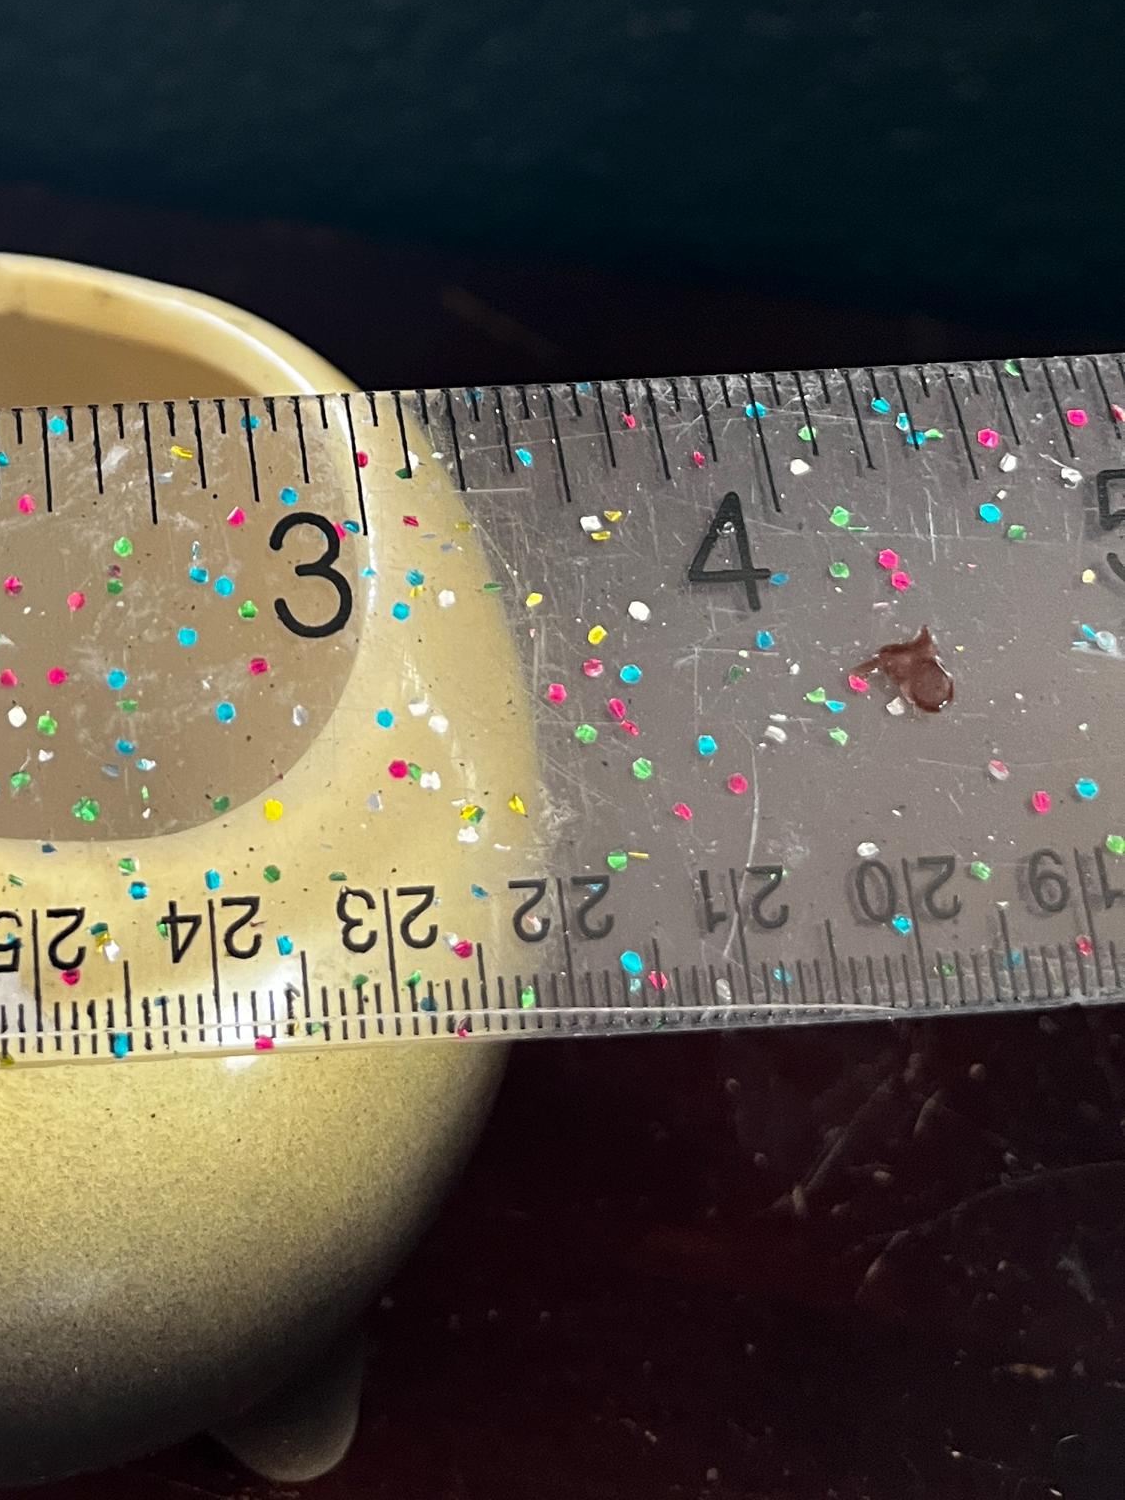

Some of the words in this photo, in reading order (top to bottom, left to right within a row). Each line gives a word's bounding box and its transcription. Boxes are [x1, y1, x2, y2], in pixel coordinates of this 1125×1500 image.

[269, 511, 353, 638] 3
[687, 491, 771, 611] 4
[507, 874, 615, 943] 22
[698, 864, 788, 933] 21
[854, 854, 962, 923] 20
[1028, 848, 1125, 912] 19
[161, 896, 262, 963] 24
[336, 886, 438, 954] 23
